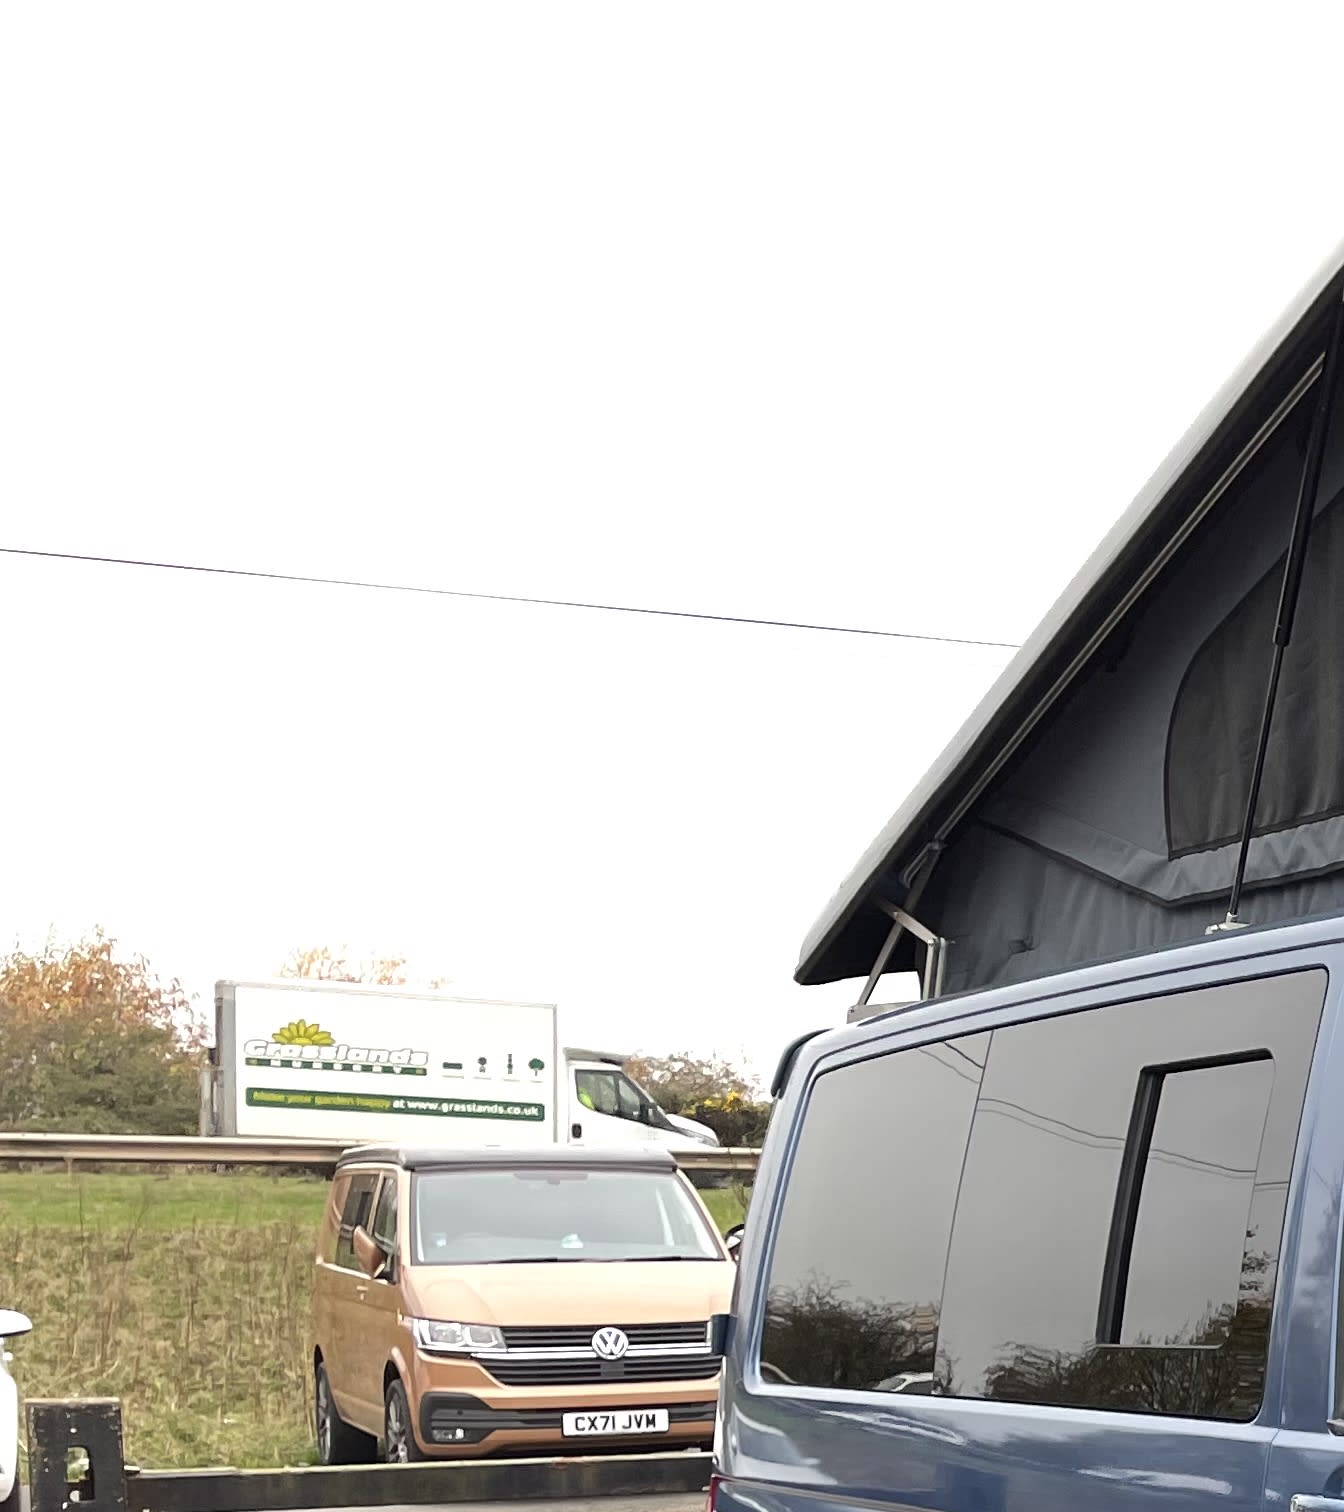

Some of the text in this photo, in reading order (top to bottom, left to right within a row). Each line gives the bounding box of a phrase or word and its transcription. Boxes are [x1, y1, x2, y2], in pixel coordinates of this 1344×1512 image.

[244, 1039, 429, 1066] Grasslands
[392, 1099, 406, 1109] at
[407, 1100, 539, 1117] www.grasslands.co.uk
[575, 1413, 656, 1431] CX71 JVM
